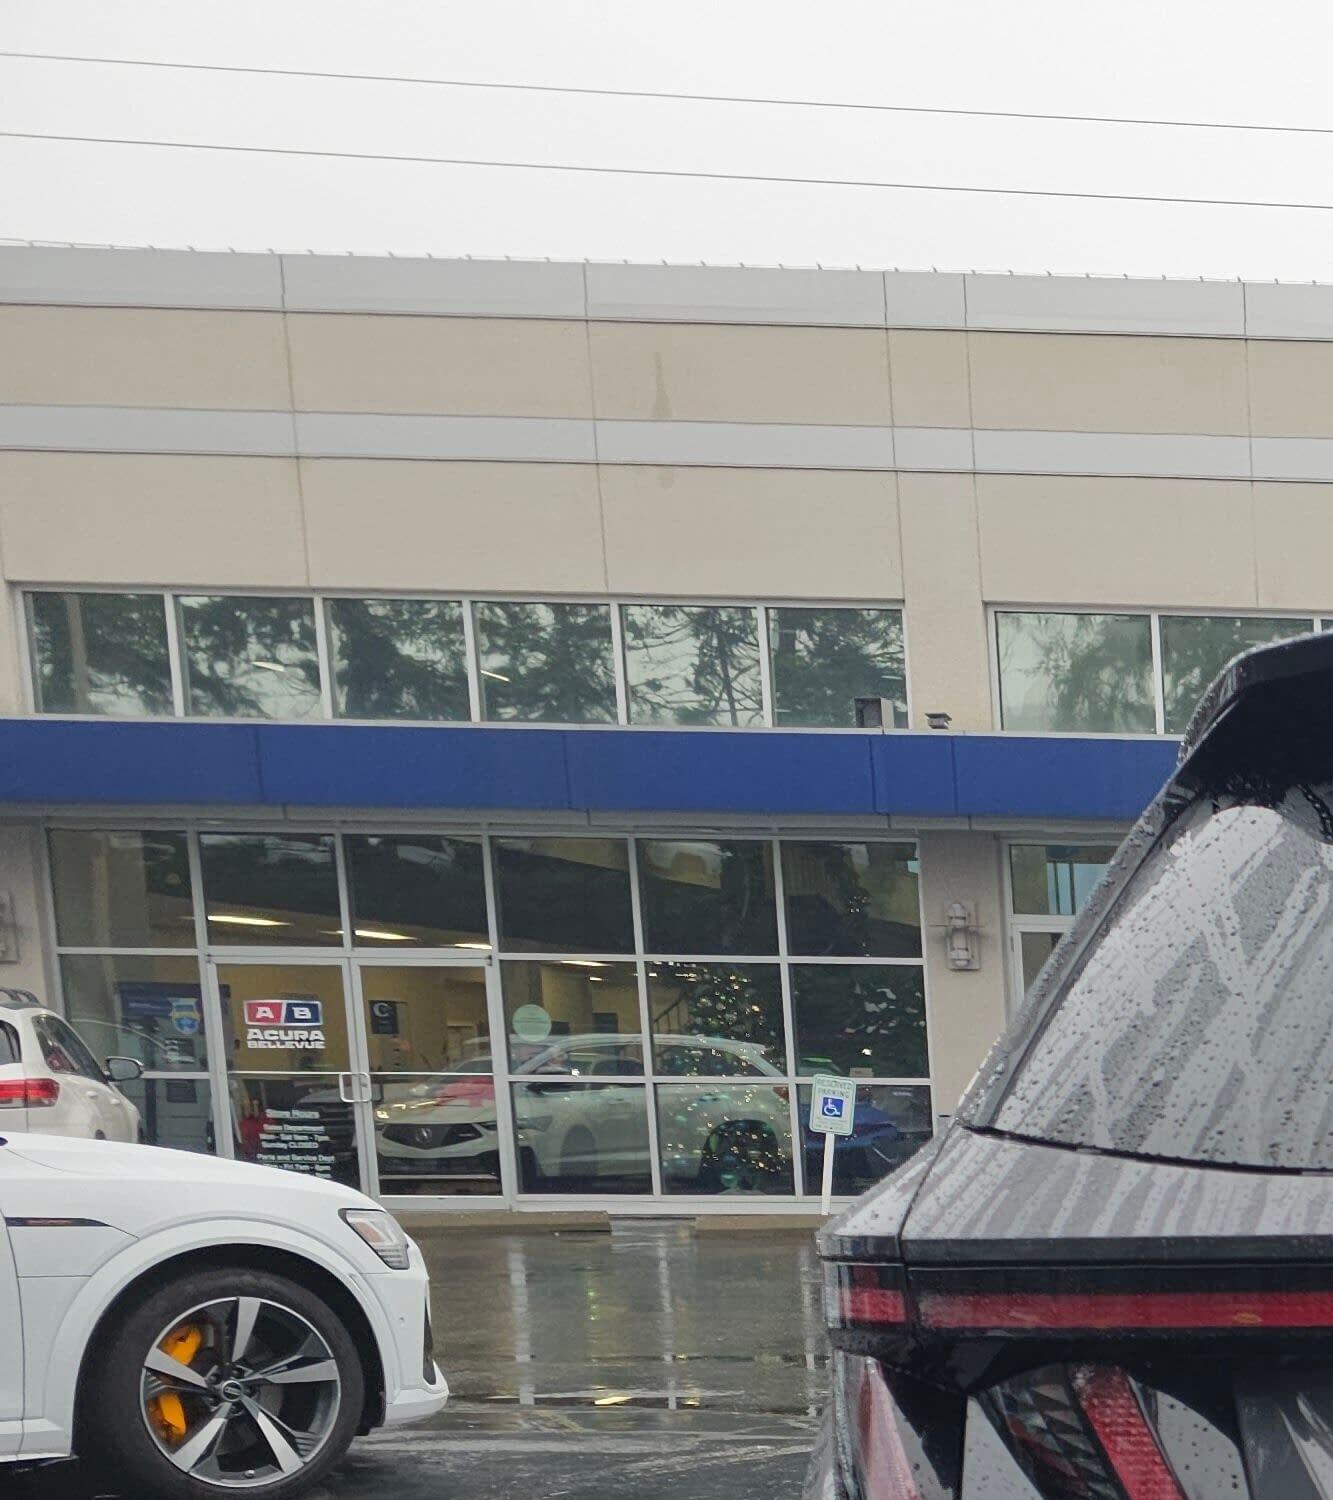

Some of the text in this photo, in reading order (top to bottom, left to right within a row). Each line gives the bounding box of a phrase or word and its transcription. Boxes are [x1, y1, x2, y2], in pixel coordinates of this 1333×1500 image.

[255, 1006, 312, 1019] A B
[247, 1028, 325, 1041] ACURA
[247, 1040, 326, 1049] BELLEVUE
